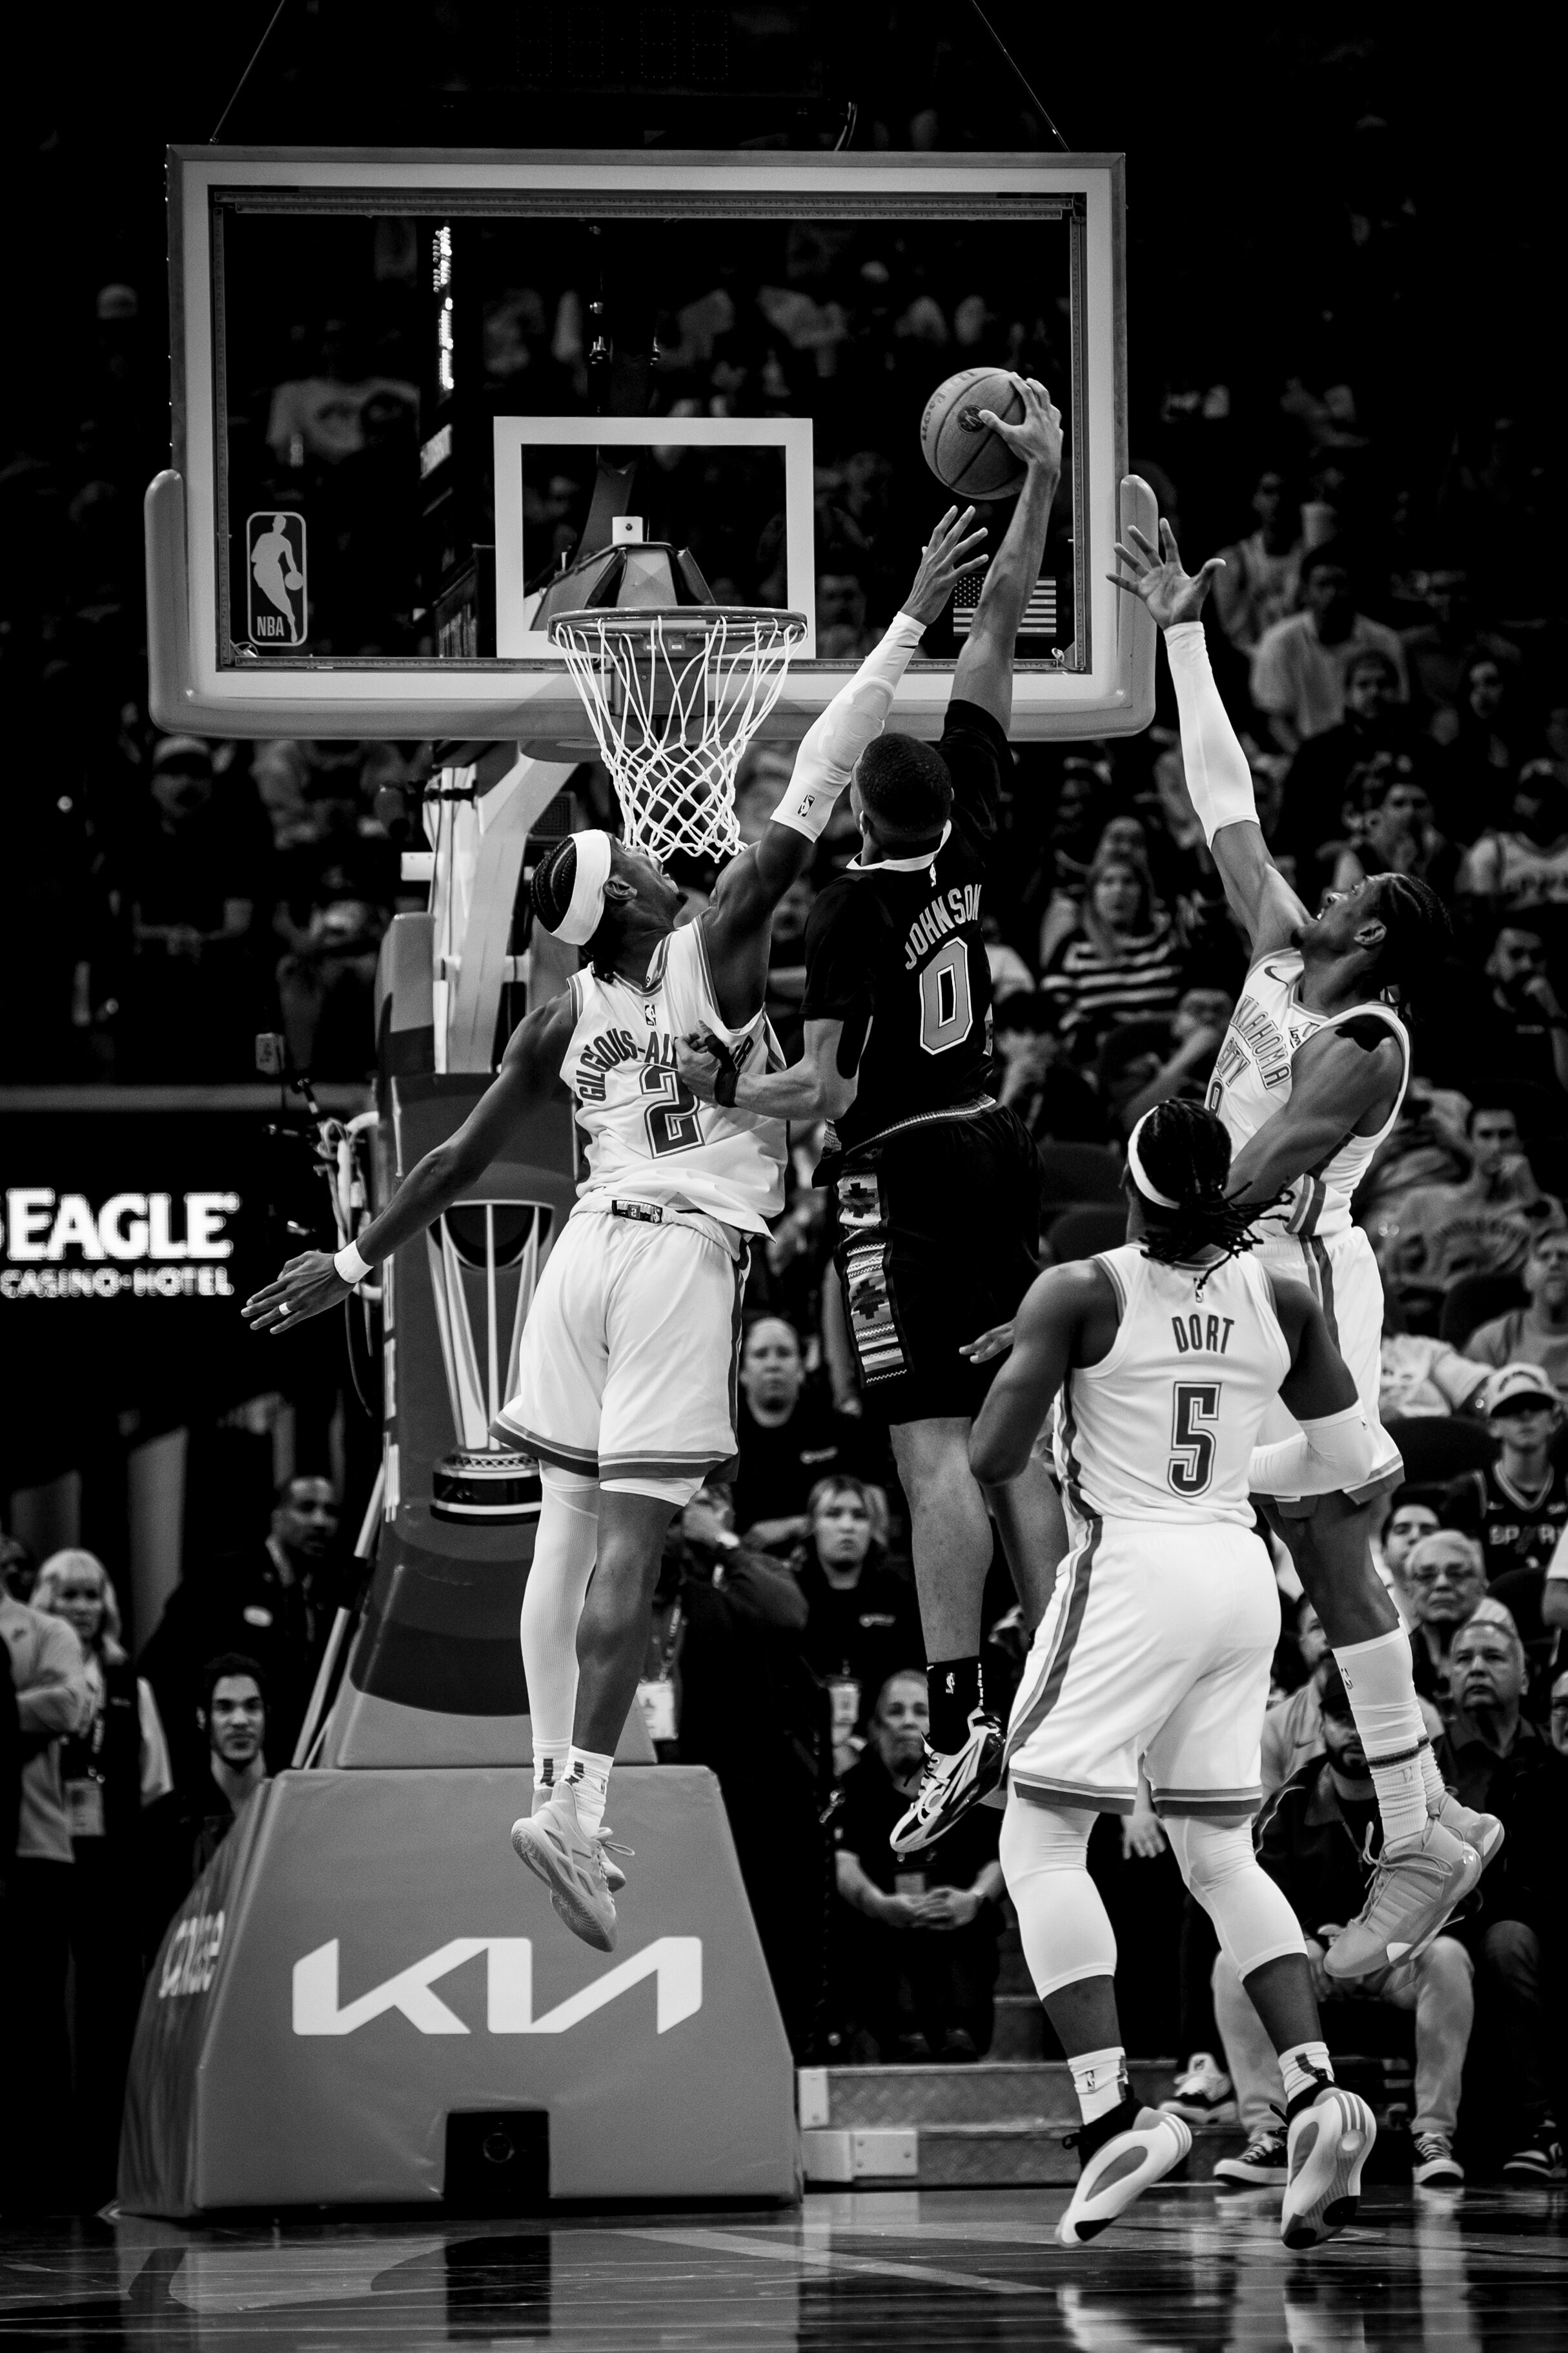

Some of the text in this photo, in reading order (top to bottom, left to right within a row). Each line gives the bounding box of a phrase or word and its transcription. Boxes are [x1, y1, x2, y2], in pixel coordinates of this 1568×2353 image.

[257, 615, 285, 637] NBA
[904, 883, 982, 970] JOHNSON
[919, 936, 973, 1055] 0
[1229, 994, 1292, 1090] KLAHOMA
[639, 1063, 706, 1160] 2
[6, 1187, 241, 1261] EAGLE
[1172, 1313, 1234, 1354] DORT
[1167, 1381, 1222, 1497] 5
[292, 1937, 702, 2035] KIA
